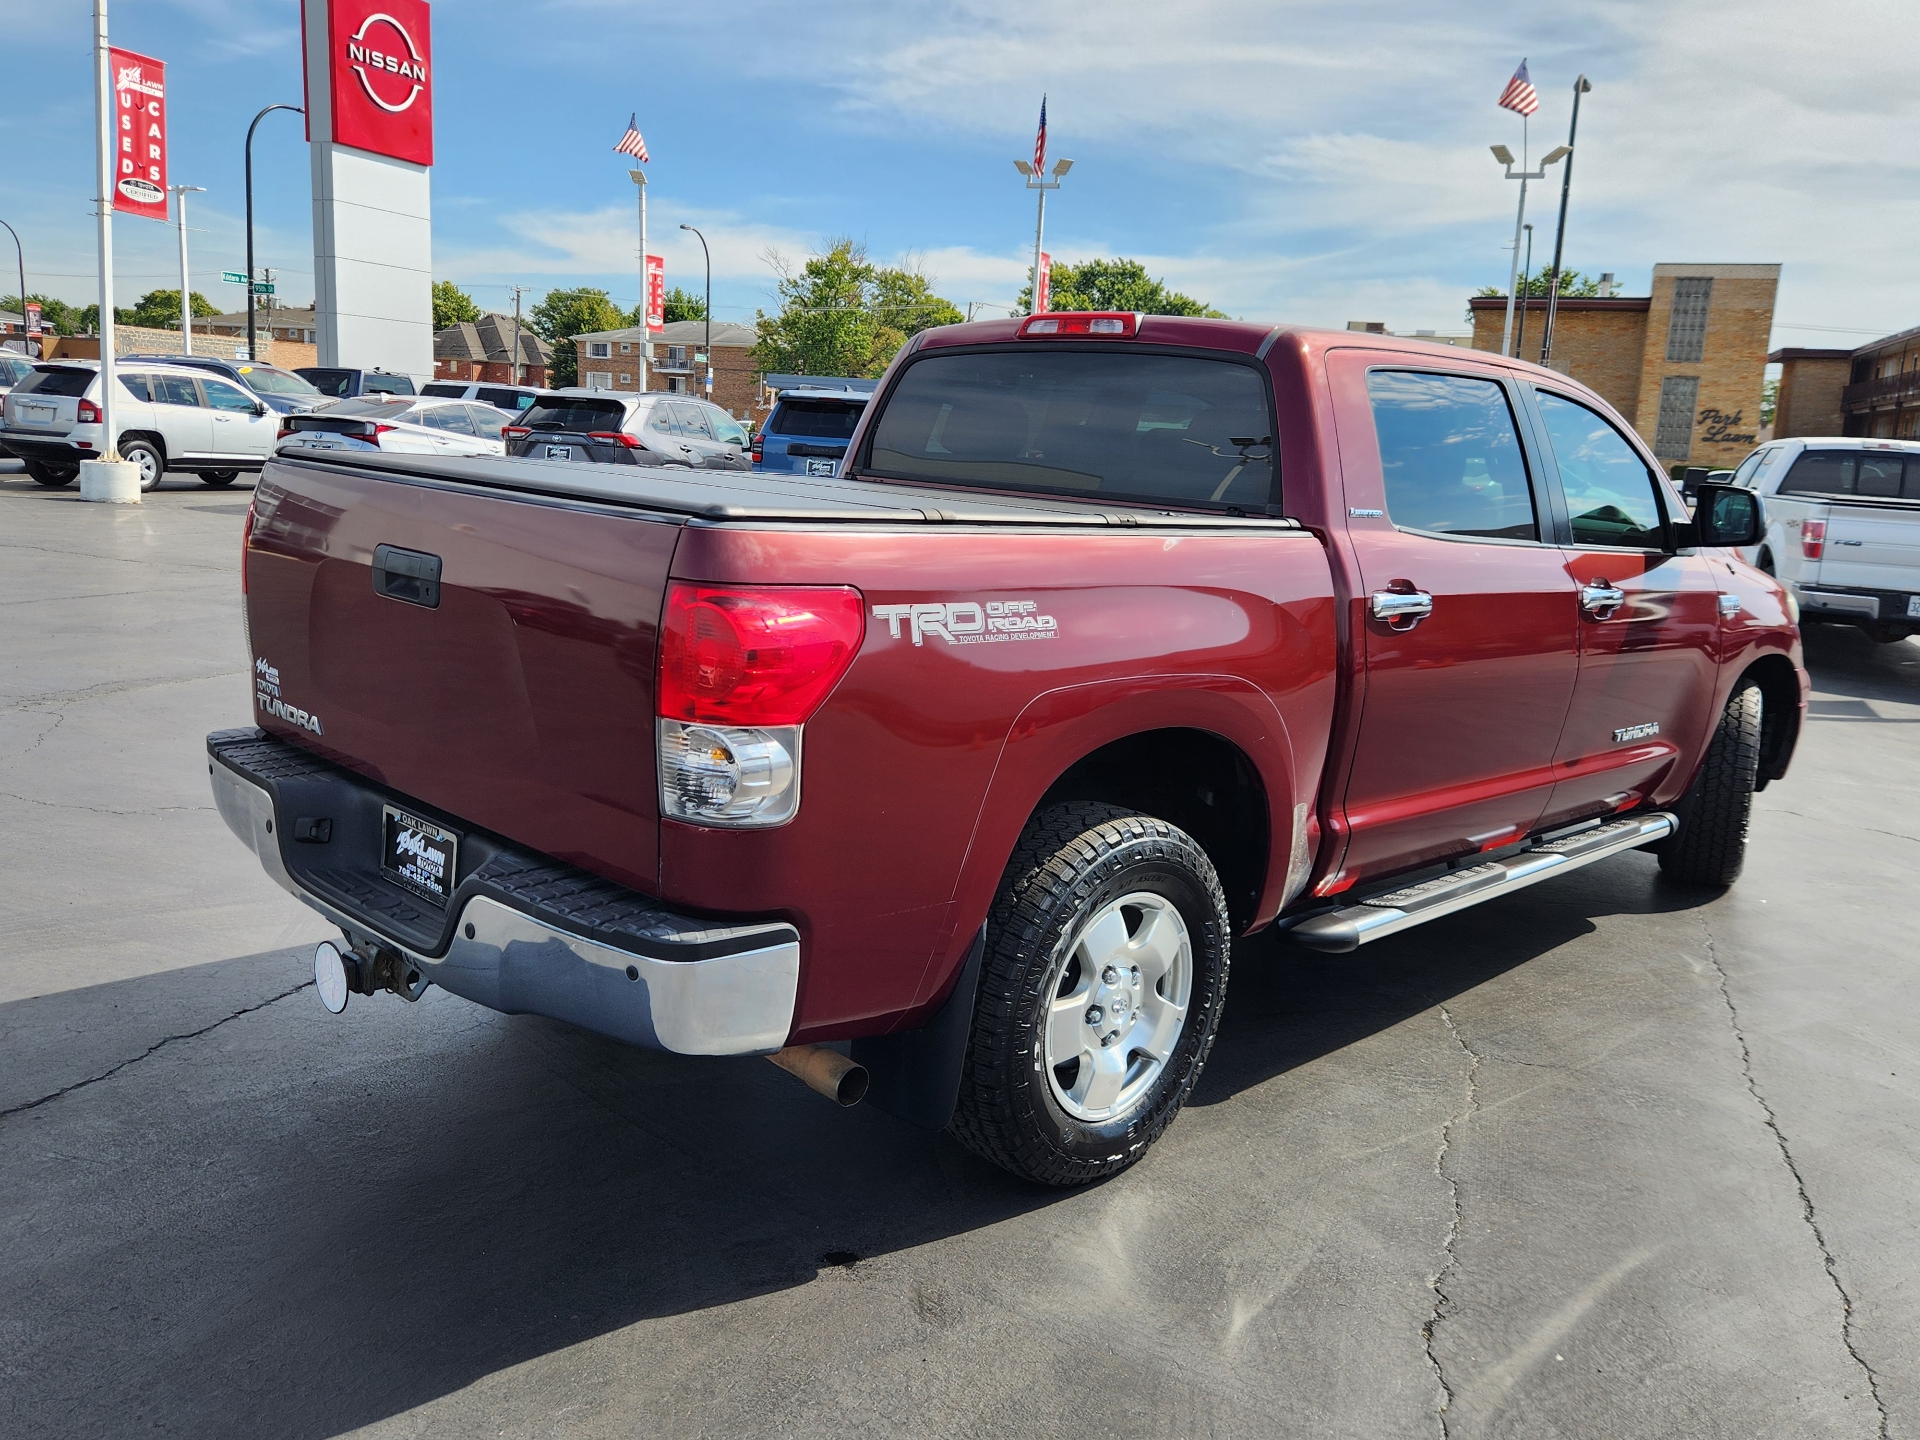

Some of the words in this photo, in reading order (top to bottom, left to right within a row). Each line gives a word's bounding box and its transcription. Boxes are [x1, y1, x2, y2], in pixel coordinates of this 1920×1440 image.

[348, 42, 426, 82] NISSAN
[120, 92, 134, 174] USED
[148, 101, 162, 181] CARS
[254, 284, 267, 293] 95th
[267, 285, 274, 293] St
[5, 340, 36, 352] Solle's
[1697, 409, 1742, 425] Park
[1701, 426, 1756, 444] Lawn
[872, 602, 985, 647] TRD
[985, 600, 1037, 616] OFF
[987, 615, 1058, 632] ROAD
[958, 634, 984, 643] TOYOTA
[985, 634, 1010, 642] RACING
[1010, 631, 1055, 640] DEVELOPMENT
[256, 678, 281, 698] TOYOTA
[257, 691, 325, 736] TUNDRA
[1613, 722, 1660, 743] TUNDRA
[402, 814, 417, 828] OAK
[417, 821, 438, 837] LAWN
[398, 864, 443, 893] 708-423-5200
